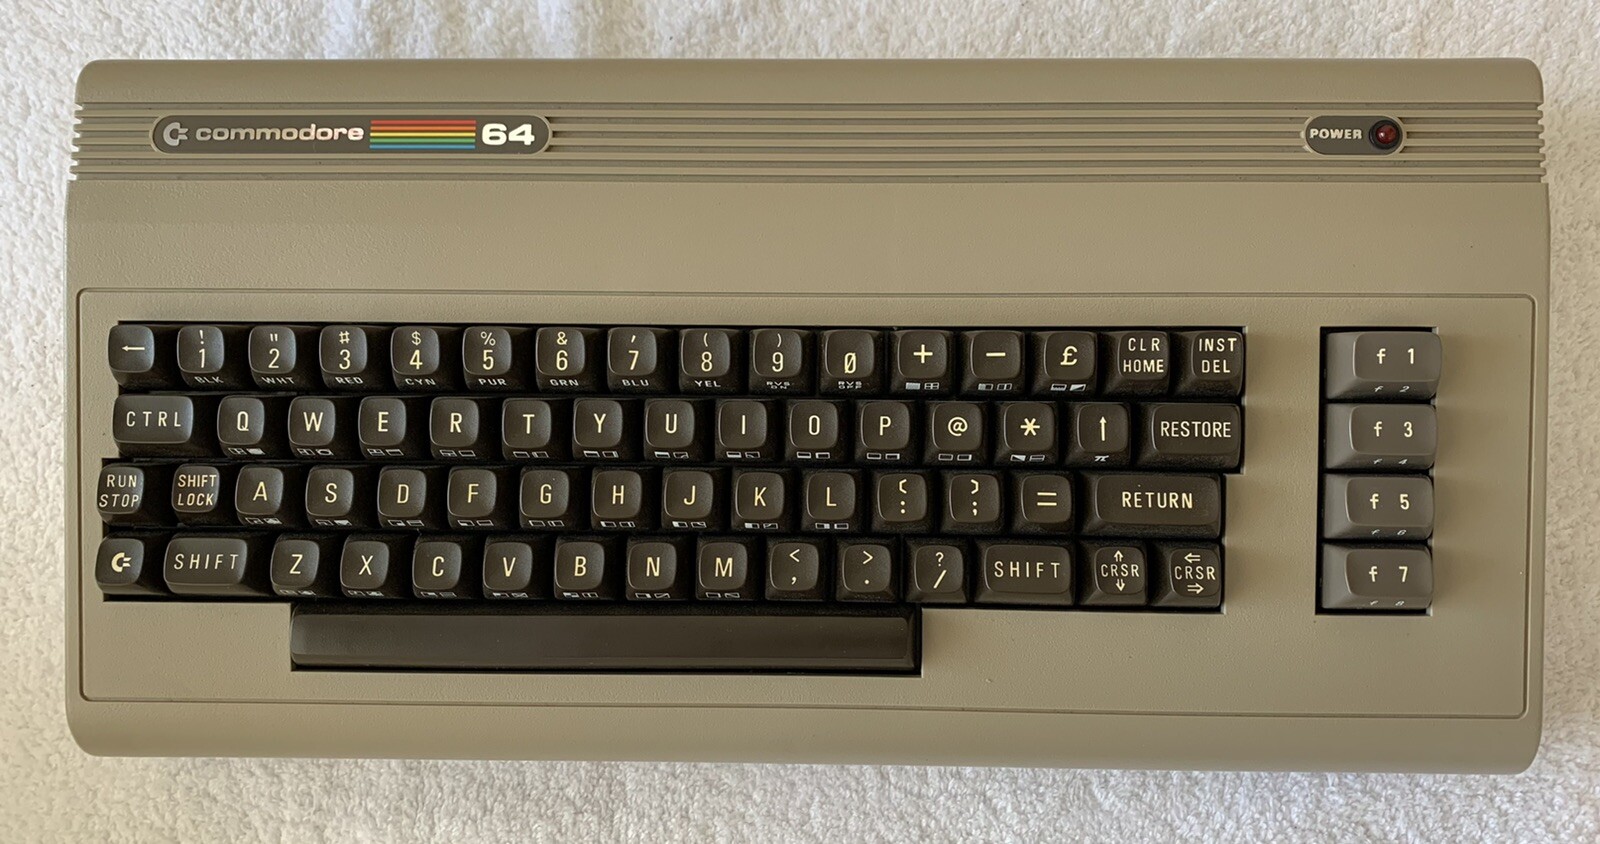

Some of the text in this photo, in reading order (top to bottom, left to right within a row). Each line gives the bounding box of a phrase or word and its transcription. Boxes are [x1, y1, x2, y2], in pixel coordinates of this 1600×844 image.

[196, 123, 535, 146] commodore 64
[1309, 128, 1362, 139] POWER
[338, 330, 350, 344] #
[411, 330, 422, 346] $
[480, 331, 496, 346] %
[556, 331, 568, 346] &
[1128, 337, 1160, 352] CLR
[1199, 337, 1238, 352] INST
[198, 348, 206, 369] 1
[268, 348, 280, 369] 2
[339, 349, 351, 370] 3
[409, 349, 423, 370] 4
[482, 349, 494, 371] 5
[556, 349, 568, 371] 6
[628, 350, 639, 371] 7
[701, 351, 713, 372] 8
[772, 351, 784, 373] 9
[1060, 345, 1078, 366] £
[1123, 359, 1164, 373] HOME
[1201, 359, 1231, 373] DEL
[261, 376, 295, 384] WHT
[335, 376, 364, 384] RED
[478, 378, 507, 386] PUR
[694, 380, 722, 388] YEL
[126, 411, 182, 427] CTRL
[237, 410, 249, 432] Q
[303, 411, 324, 432] W
[377, 411, 389, 432] E
[450, 412, 463, 433] R
[522, 413, 535, 434] T
[593, 413, 607, 434] Y
[665, 413, 678, 434] U
[808, 414, 821, 436] O
[879, 415, 892, 436] P
[947, 416, 968, 437] @
[1160, 420, 1232, 438] RESTORE
[106, 474, 137, 488] RUN
[177, 474, 217, 488] SHIFT
[252, 481, 268, 501] A
[98, 493, 140, 508] STOP
[177, 492, 214, 506] LOCK
[324, 482, 338, 503] S
[397, 484, 410, 504] D
[467, 483, 479, 503] F
[540, 483, 552, 504] G
[612, 484, 625, 505] H
[683, 485, 696, 505] J
[754, 486, 767, 507] K
[826, 486, 837, 507] L
[1122, 491, 1193, 509] RETURN
[173, 553, 239, 570] SHIFT
[289, 553, 303, 575] Z
[358, 555, 374, 576] X
[432, 556, 445, 577] C
[502, 556, 516, 577] V
[574, 556, 587, 577] B
[646, 556, 660, 577] N
[715, 557, 733, 578] M
[935, 551, 944, 567] ?
[994, 560, 1060, 579] SHIFT
[1100, 563, 1140, 578] CRSR
[1174, 565, 1216, 581] CRSR
